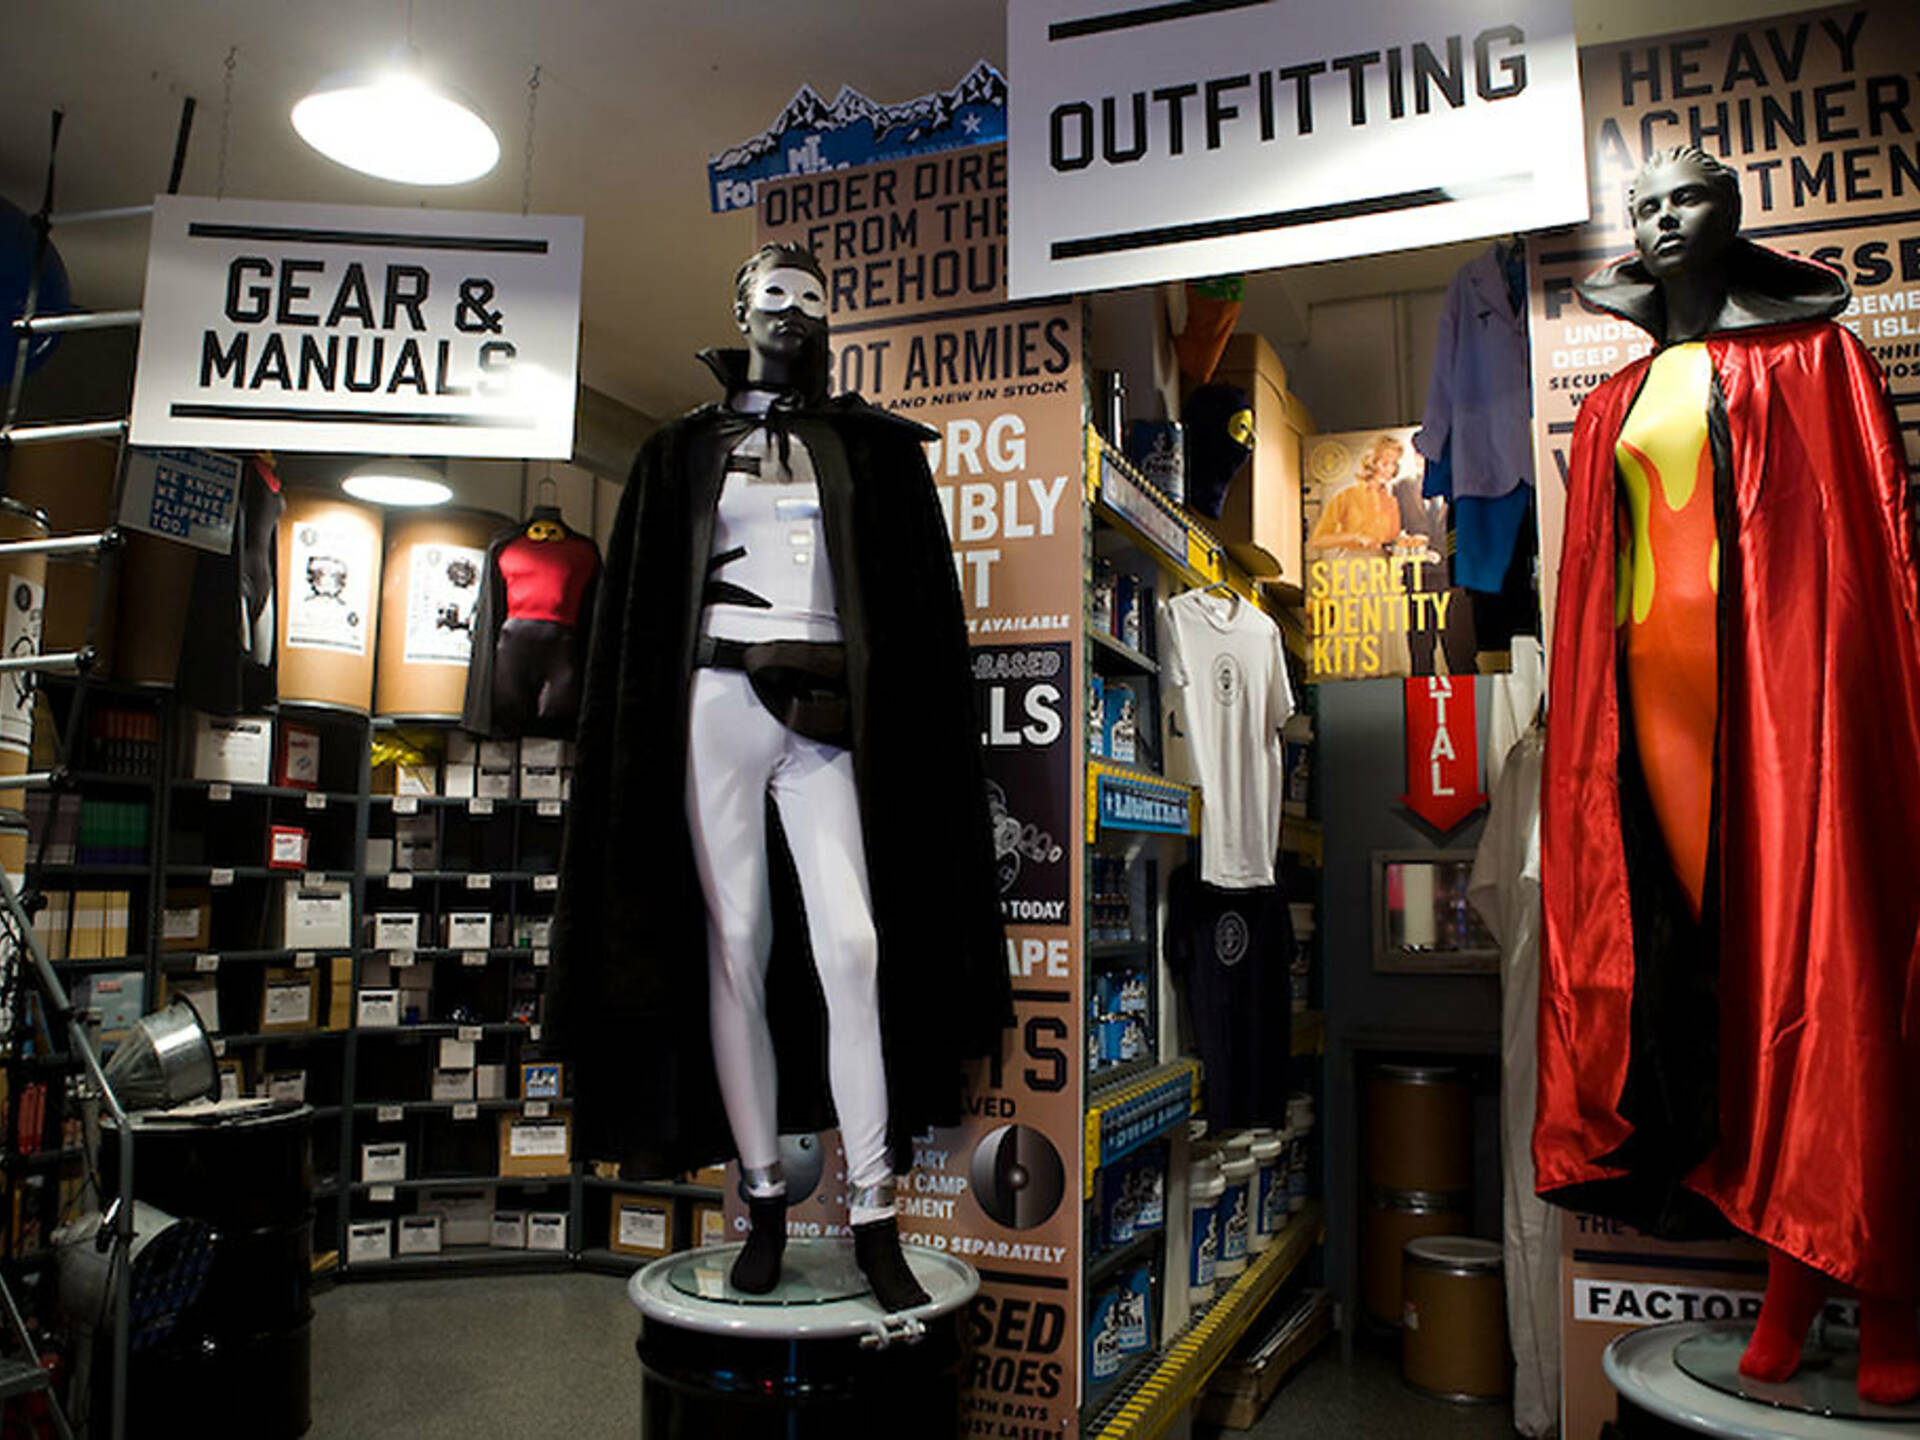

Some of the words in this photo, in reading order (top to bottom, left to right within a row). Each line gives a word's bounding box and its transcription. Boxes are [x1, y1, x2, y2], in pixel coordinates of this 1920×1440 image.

[1619, 11, 1868, 107] HEAVY
[1050, 24, 1528, 173] OUTFITTING
[1598, 72, 1920, 171] ACHINER
[765, 167, 897, 227] ORDER
[807, 209, 918, 262] FROM
[223, 256, 431, 332] GEAR
[454, 278, 503, 334] &
[830, 240, 1008, 314] REHOU
[903, 317, 1072, 392] ARMIES
[1564, 321, 1646, 346] UNDE
[199, 330, 518, 397] MANUALS
[1551, 346, 1619, 370] DEEP
[888, 396, 926, 410] AND
[932, 391, 972, 405] NEW
[977, 388, 997, 400] IN
[1002, 380, 1068, 398] STOCK
[1311, 556, 1425, 598] SECRET
[980, 613, 1070, 633] AVAILABLE
[1313, 591, 1451, 636] IDENTITY
[1314, 635, 1381, 675] KITS
[981, 683, 1063, 746] LS
[1011, 901, 1065, 919] TODAY
[915, 1172, 968, 1196] CAMP
[951, 1236, 1068, 1263] SEPARATELY
[1003, 1401, 1048, 1421] RAYS
